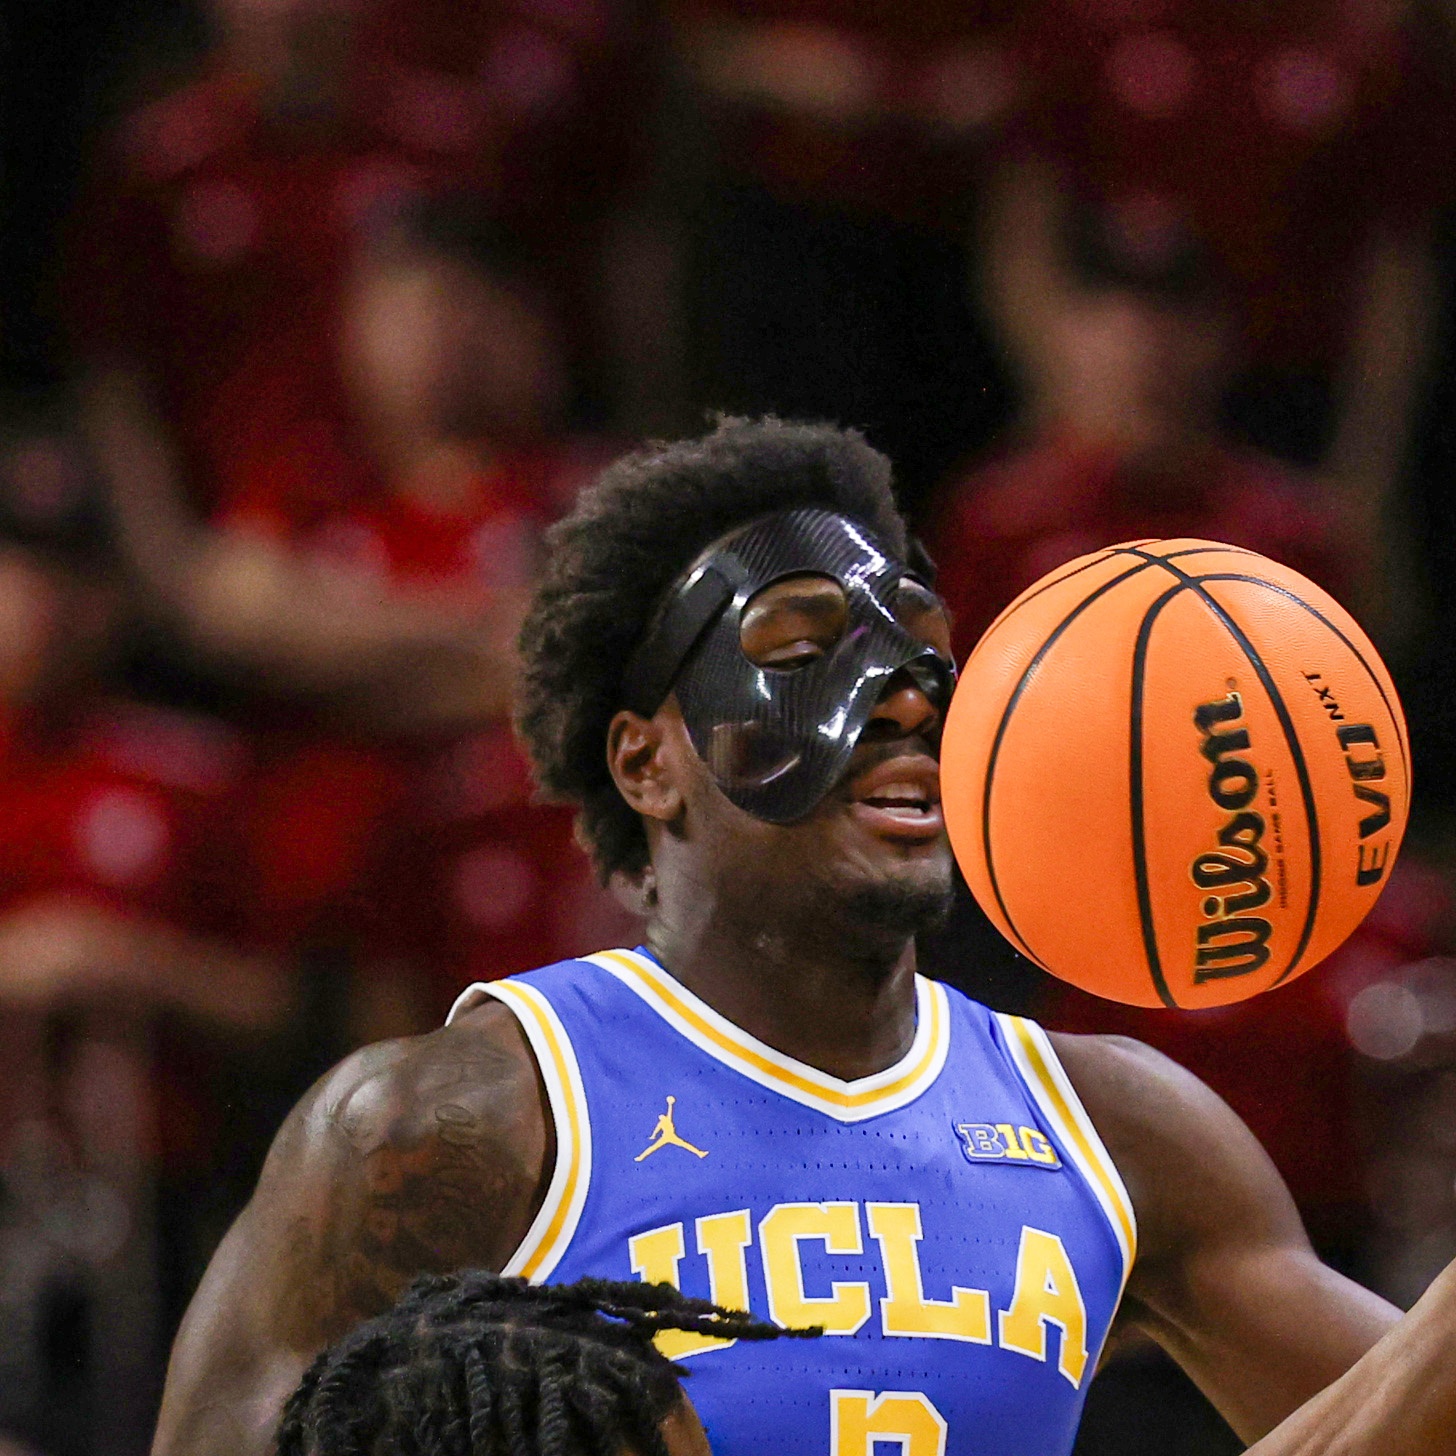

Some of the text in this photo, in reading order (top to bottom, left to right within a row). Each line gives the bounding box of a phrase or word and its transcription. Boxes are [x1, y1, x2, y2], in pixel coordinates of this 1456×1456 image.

[1300, 670, 1344, 720] NXT
[1190, 690, 1272, 986] Wilson
[1265, 768, 1277, 806] BALL
[1272, 813, 1284, 853] GAME
[1336, 723, 1392, 887] EVO
[628, 1200, 1089, 1389] UCLA
